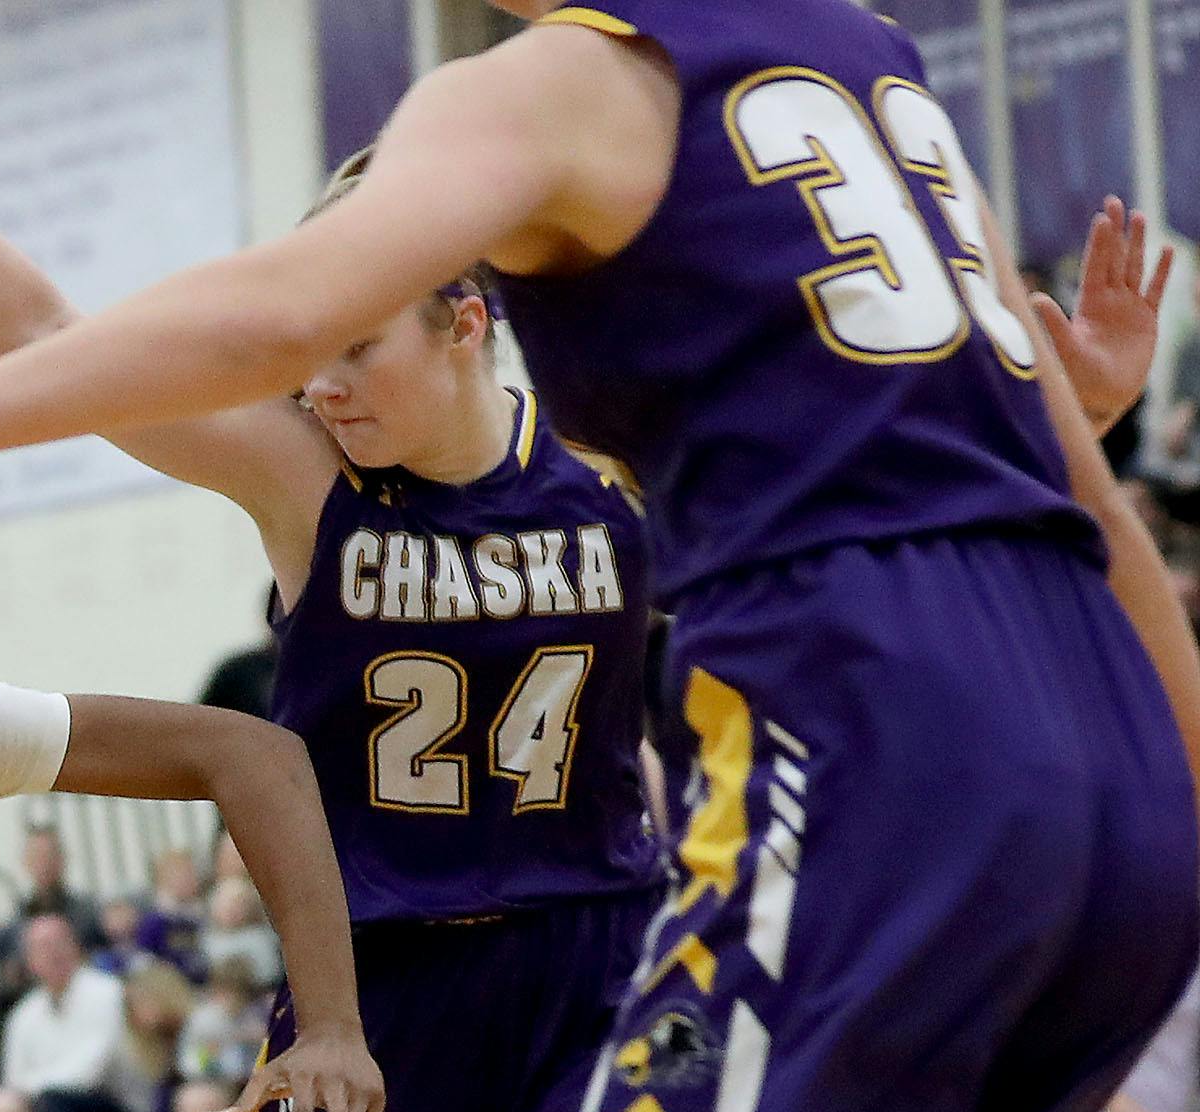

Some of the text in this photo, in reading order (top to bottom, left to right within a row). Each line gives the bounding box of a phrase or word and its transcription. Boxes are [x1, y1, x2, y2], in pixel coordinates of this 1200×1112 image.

[722, 65, 1038, 381] 33
[340, 523, 625, 623] CHASKA
[363, 644, 594, 816] 24
